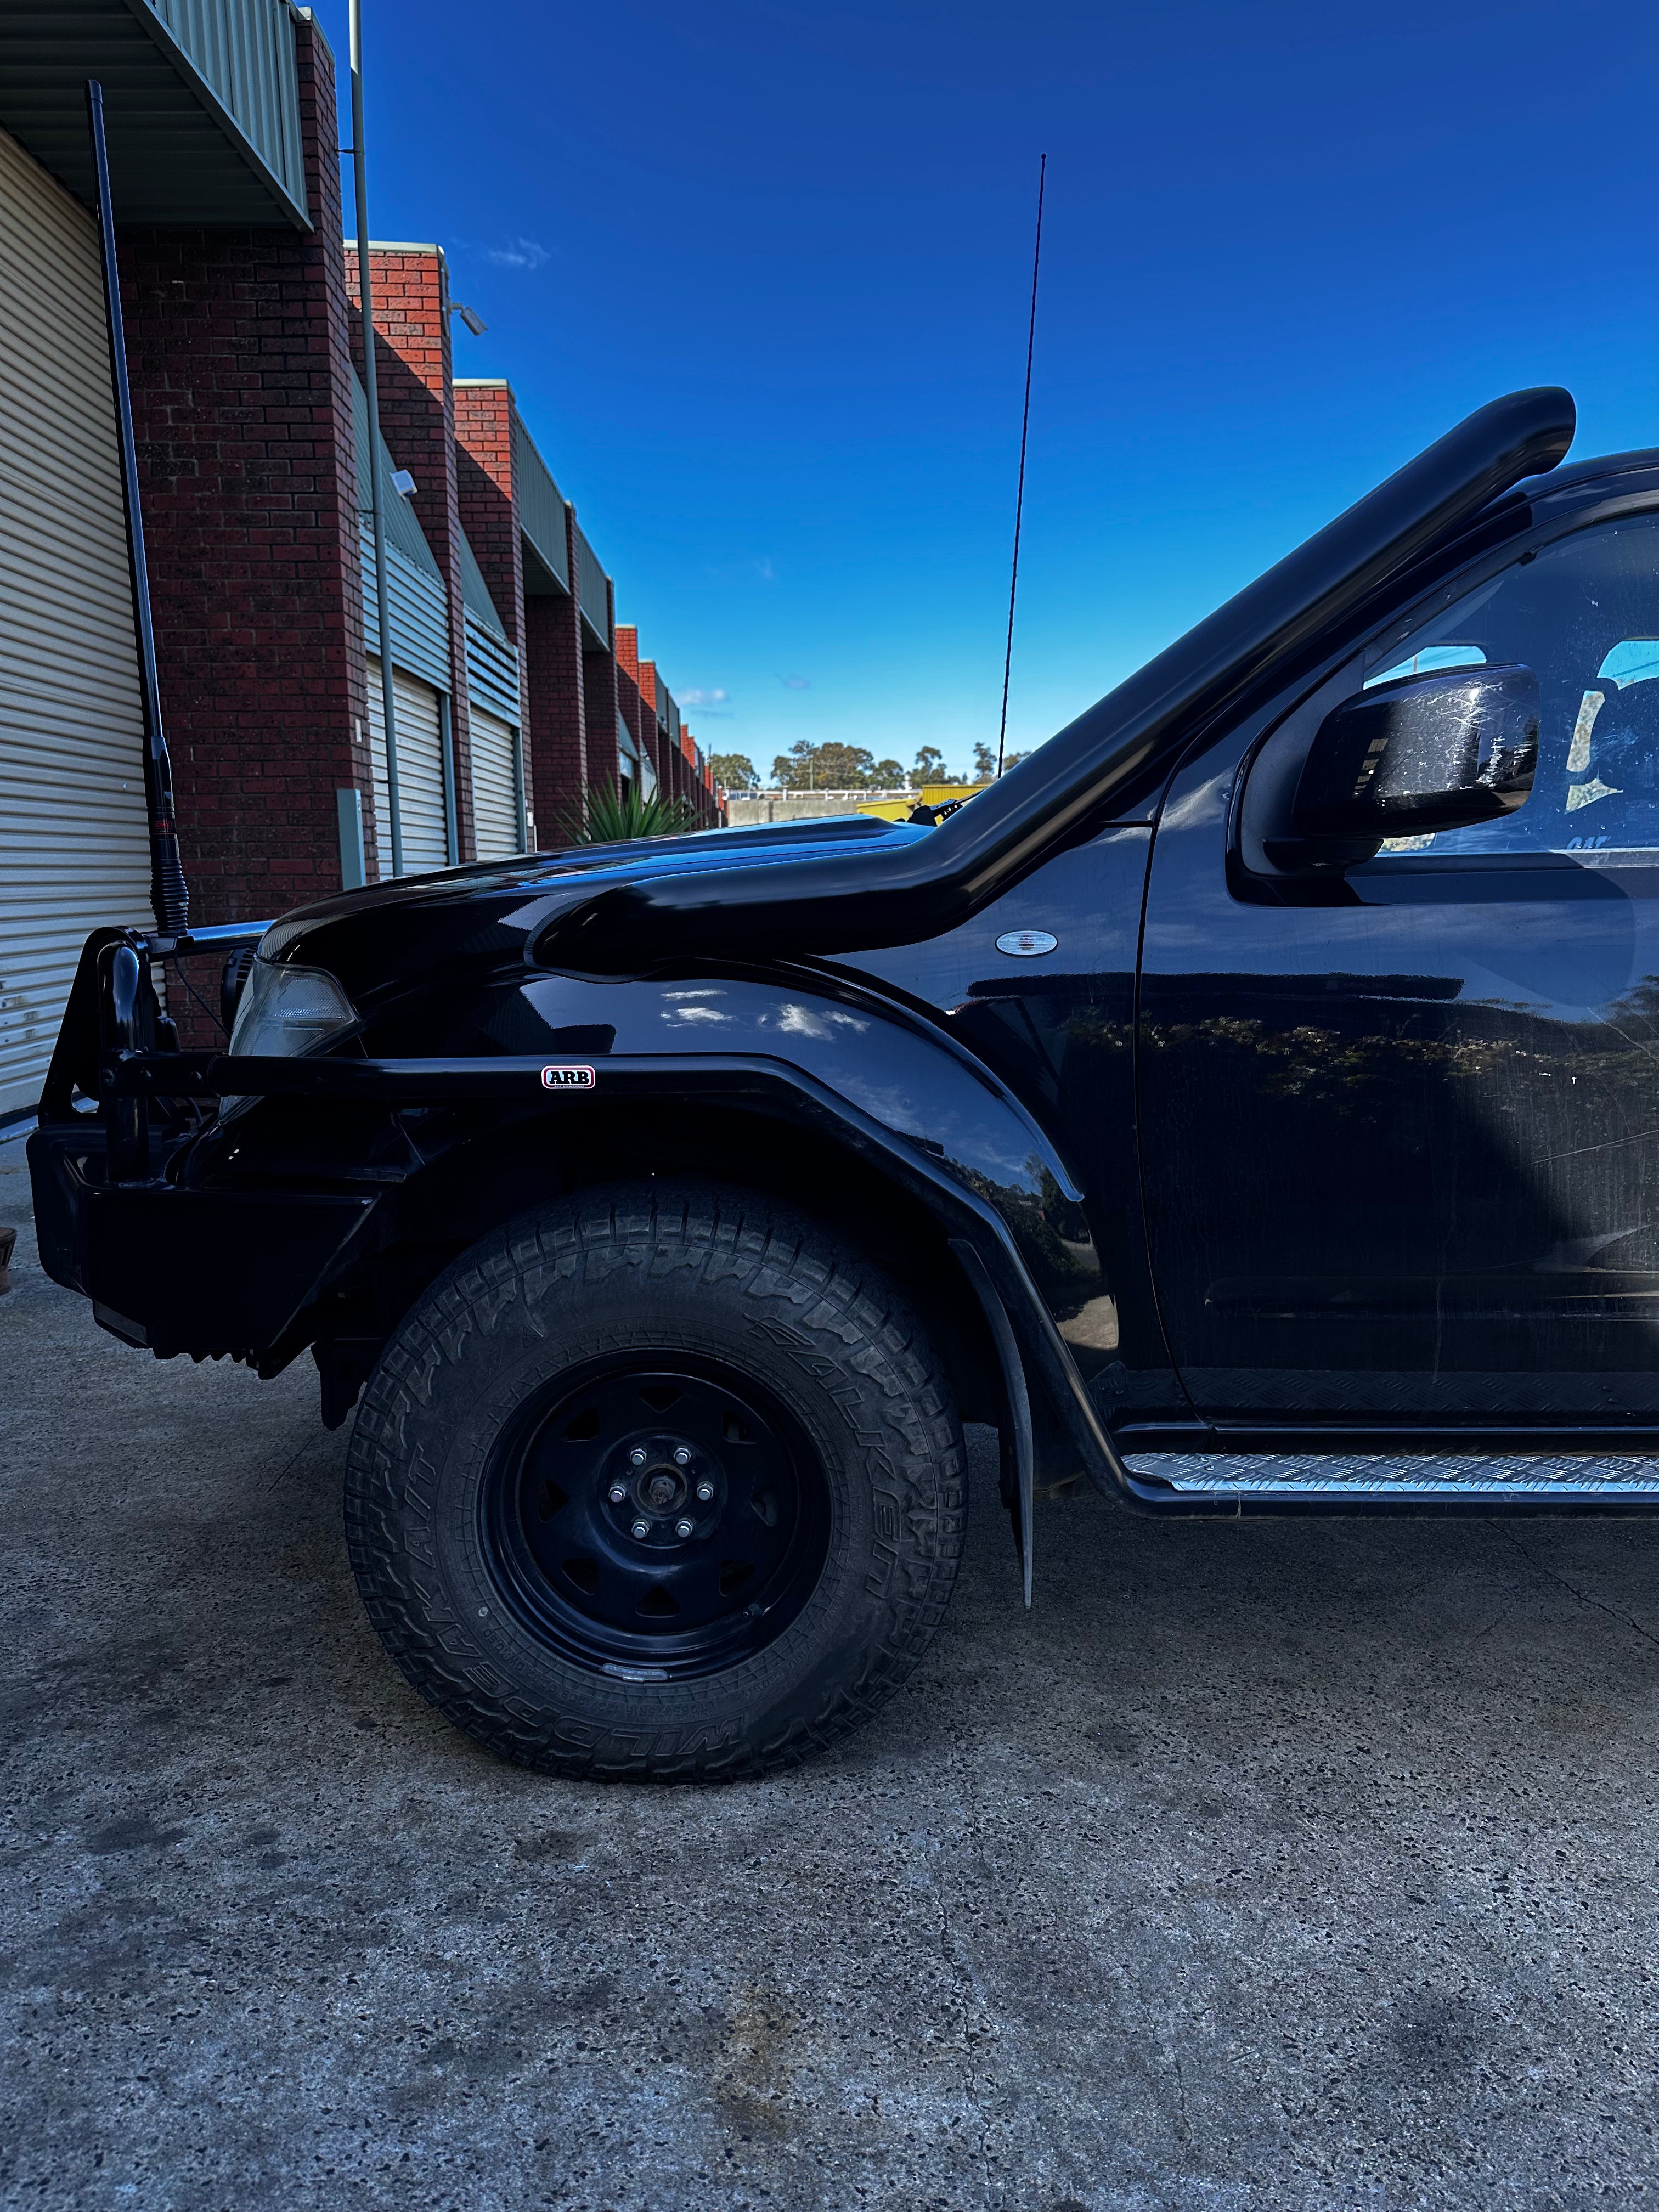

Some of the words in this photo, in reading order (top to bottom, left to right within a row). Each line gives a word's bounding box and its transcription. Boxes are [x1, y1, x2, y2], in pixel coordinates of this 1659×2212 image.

[549, 1071, 589, 1084] ARB
[743, 1313, 901, 1599] FALKEN
[409, 1576, 745, 1757] WILDPEAK
